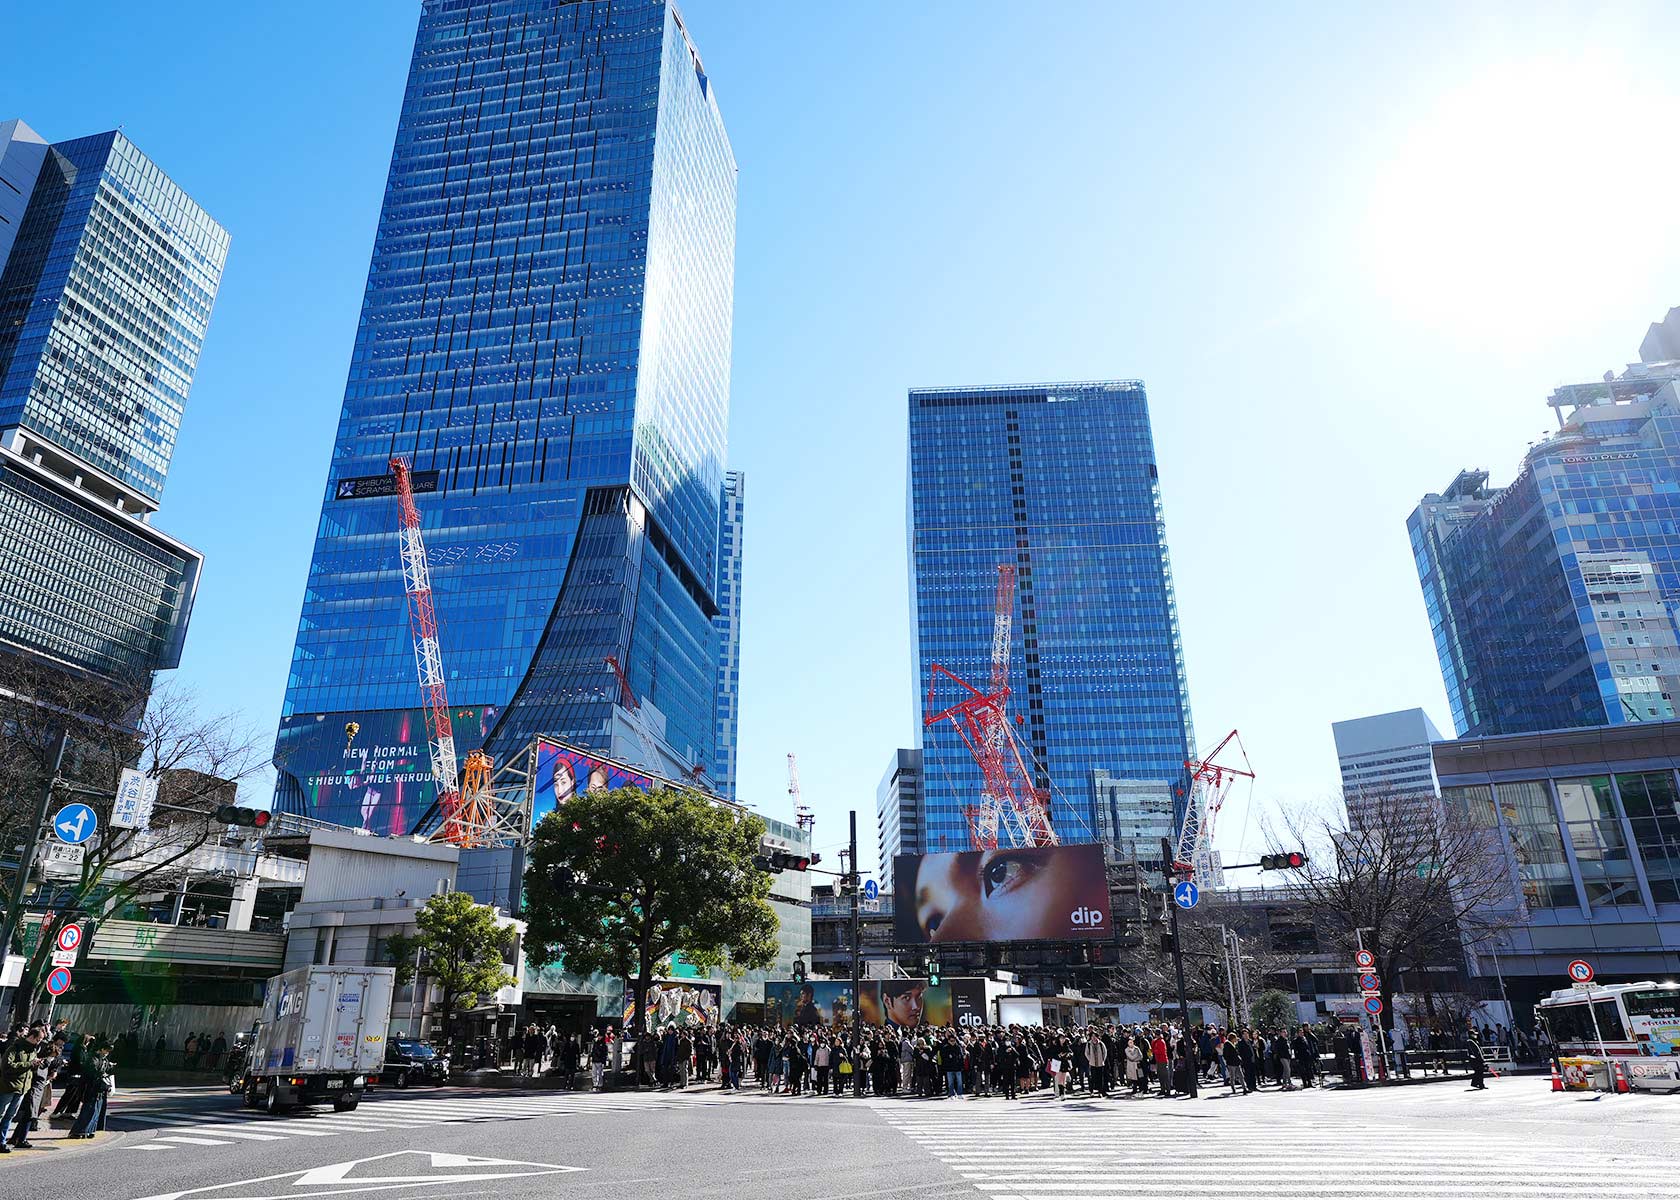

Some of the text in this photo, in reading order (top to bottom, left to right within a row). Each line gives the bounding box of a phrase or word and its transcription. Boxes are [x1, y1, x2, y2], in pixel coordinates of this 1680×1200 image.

[1561, 452, 1639, 464] TOKYU PLAZA
[356, 478, 392, 488] SHIBUYA
[343, 746, 418, 759] NEW NORMAL
[364, 759, 395, 770] FROM
[121, 775, 141, 824] 渋谷駅前
[1070, 906, 1103, 927] dip
[281, 991, 303, 1017] CNG
[958, 1012, 982, 1026] dip
